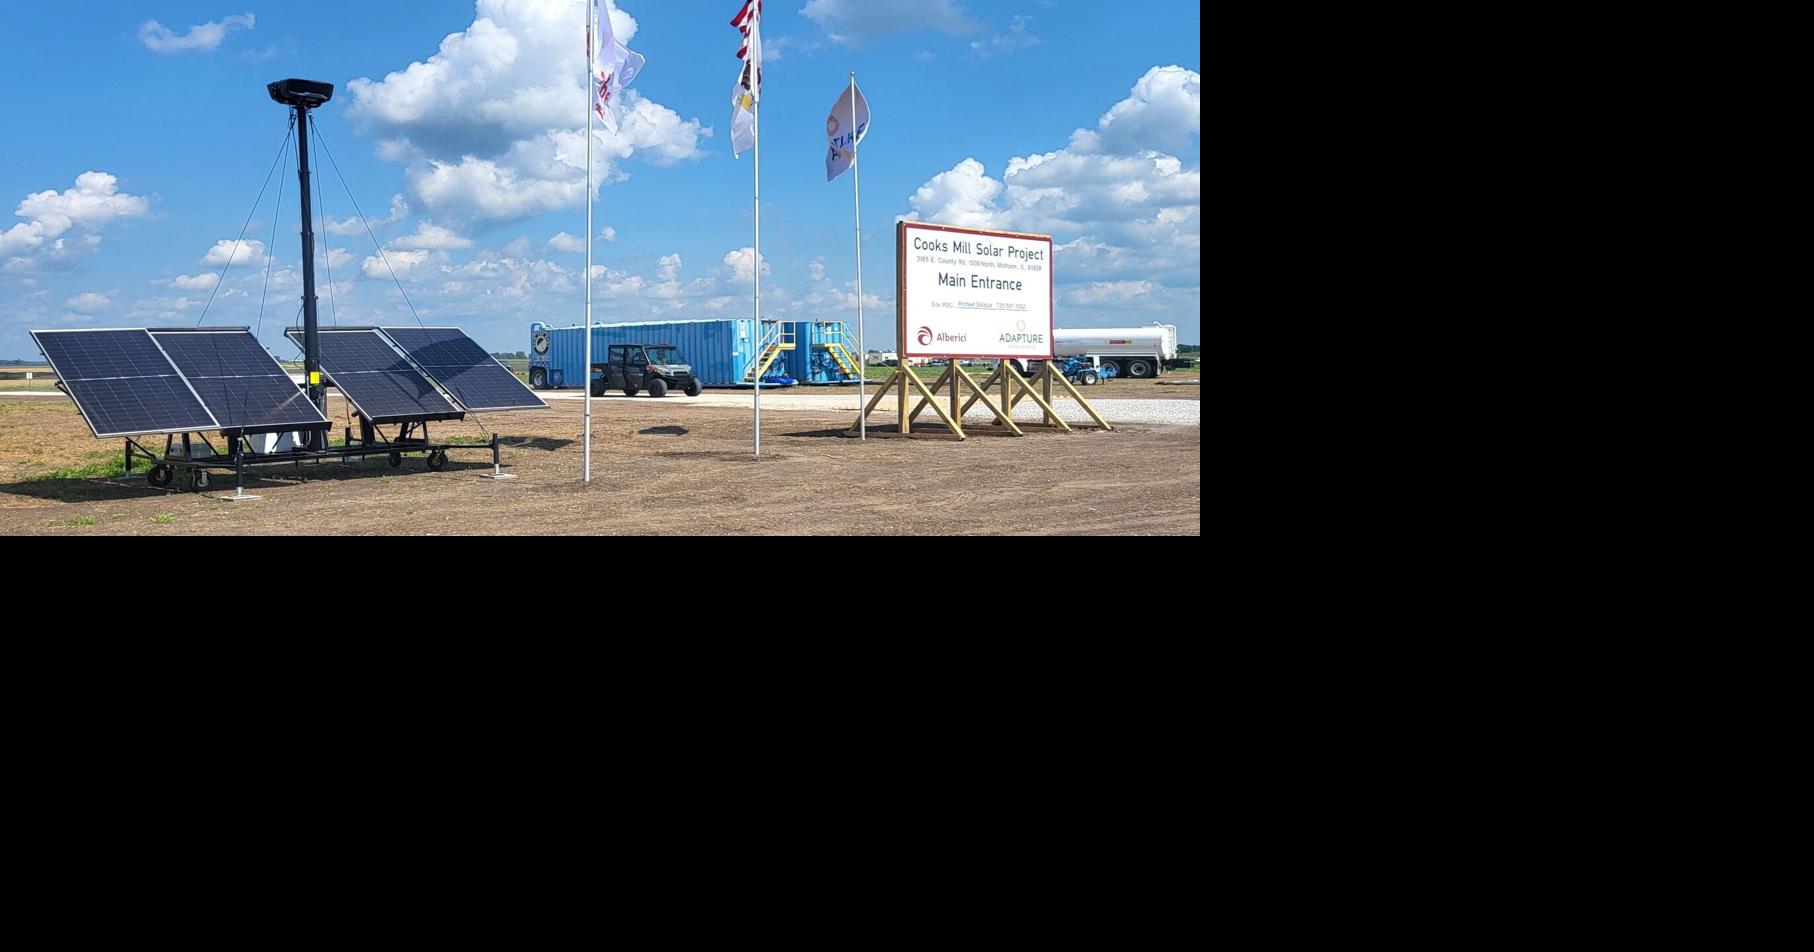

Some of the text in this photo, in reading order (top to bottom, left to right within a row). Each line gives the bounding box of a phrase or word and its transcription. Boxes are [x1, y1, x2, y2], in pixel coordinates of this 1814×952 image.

[914, 237, 1044, 262] Cooks Mill Solar Project
[938, 272, 1022, 291] Main Entrance
[936, 332, 967, 343] Alberici
[999, 332, 1044, 344] ADAPTURE
